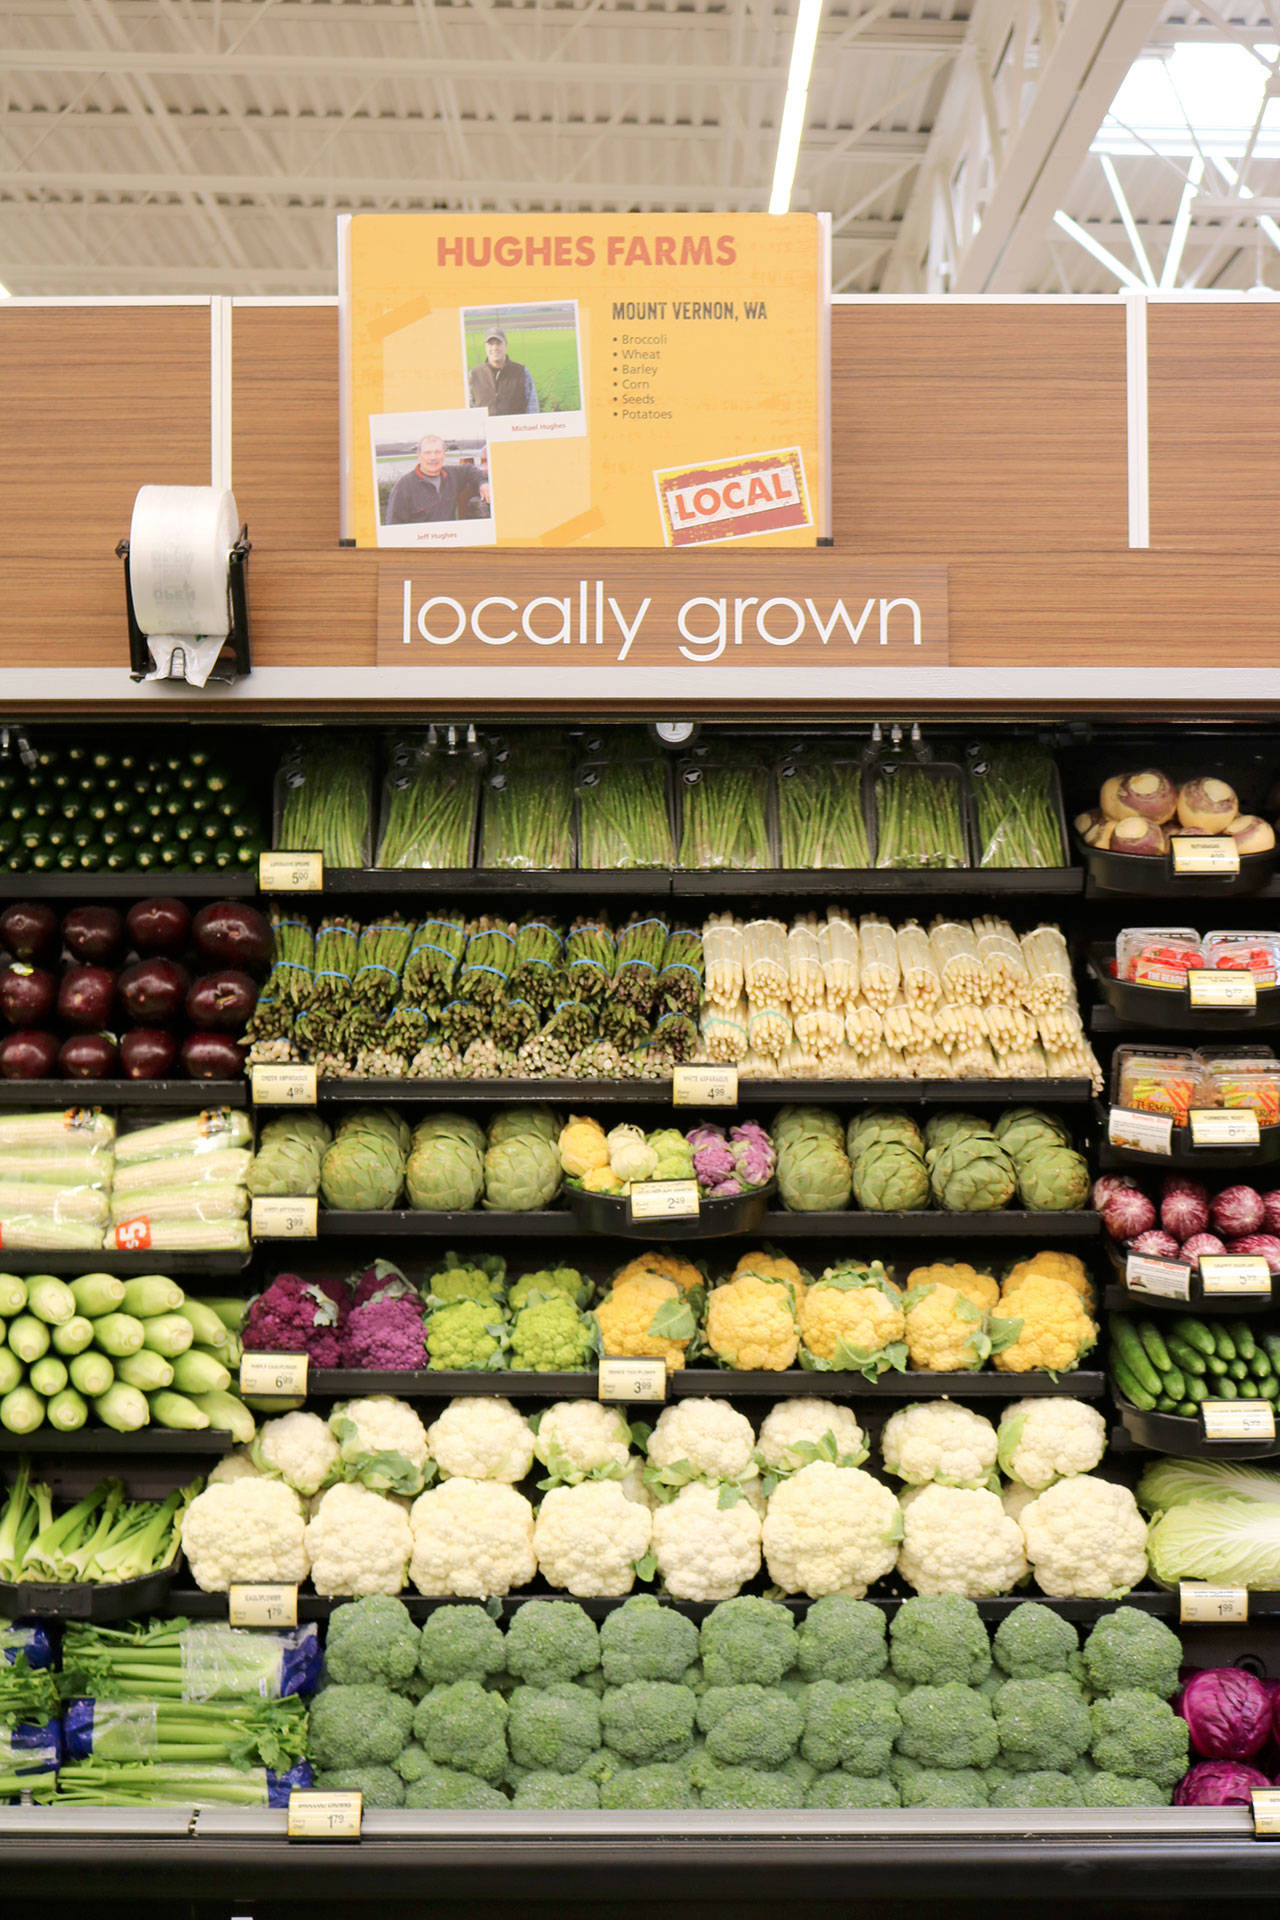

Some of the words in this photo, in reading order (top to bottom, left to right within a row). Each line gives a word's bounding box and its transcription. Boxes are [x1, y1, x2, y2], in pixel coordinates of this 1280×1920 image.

[437, 236, 596, 267] HUGHES
[607, 235, 737, 266] FARMS
[612, 301, 668, 320] MOUNT
[672, 301, 739, 322] VERNON,
[744, 301, 768, 320] WA
[622, 334, 668, 345] Broccoli
[622, 349, 661, 360] Wheat
[622, 364, 658, 377] Barley
[622, 379, 650, 390] Corn
[622, 394, 656, 405] Seeds
[622, 409, 673, 420] Potatoes
[674, 473, 793, 522] LOCAL
[402, 580, 652, 661] locally
[677, 596, 922, 662] grown
